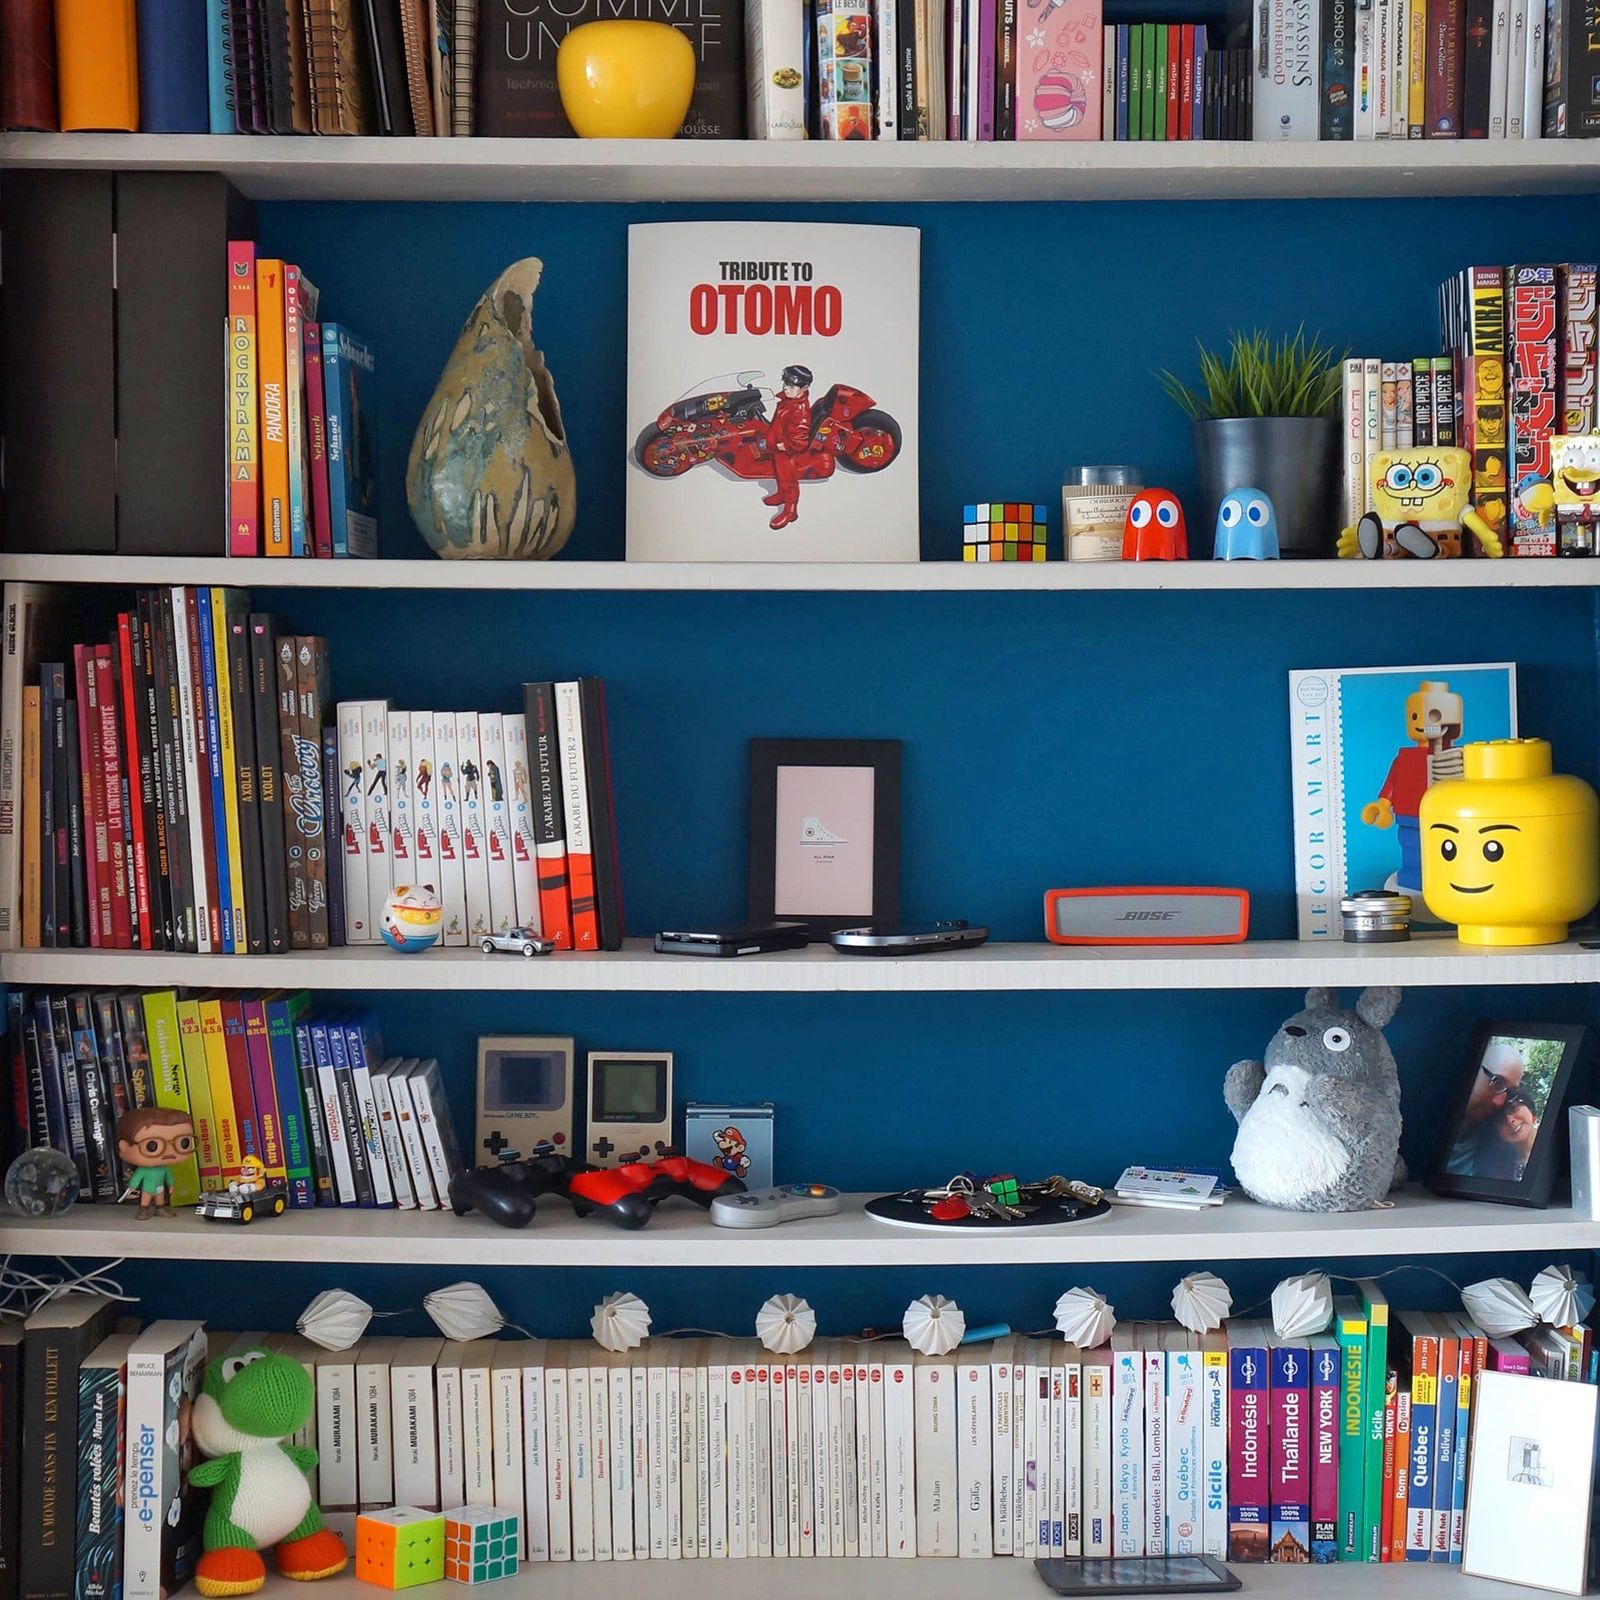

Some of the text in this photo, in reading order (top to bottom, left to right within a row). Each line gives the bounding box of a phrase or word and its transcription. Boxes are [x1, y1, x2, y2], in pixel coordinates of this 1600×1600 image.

[1362, 17, 1370, 62] TrackMania
[906, 73, 912, 82] sa
[1447, 41, 1455, 109] REVELATION
[905, 90, 913, 110] Sushi
[719, 261, 812, 281] TRIBUTE TO
[1518, 268, 1553, 284] 少年
[288, 287, 296, 333] OTOMO
[690, 284, 842, 336] OTOMO
[1475, 292, 1504, 354] AKIRA
[235, 318, 250, 481] ROCKYRAMA
[267, 383, 283, 442] PANDORA
[1352, 390, 1360, 439] FLCL
[1369, 391, 1377, 439] FLCL
[1416, 375, 1430, 423] ONE PIECE
[1437, 375, 1452, 439] ONE PIECE 69
[330, 414, 338, 461] Schnock
[87, 660, 96, 707] FLUIDE GLACIAL
[148, 688, 156, 714] VENDRE
[170, 686, 178, 717] BLACKSAD
[207, 686, 215, 716] BLACKSAD
[149, 726, 158, 748] FIERTÉ
[150, 716, 157, 724] DE
[100, 705, 121, 829] LA FONTAINE DE MÉDIOCRITÉ
[240, 765, 253, 802] AXOLOT
[261, 765, 274, 802] AXOLOT
[538, 735, 551, 791] DU FUTUR
[568, 745, 579, 781] FUTUR
[168, 783, 176, 824] SHOTGUN ET
[570, 784, 580, 800] DU
[0, 801, 13, 834] BLOTCH
[157, 814, 166, 847] BARCCO
[1305, 712, 1328, 937] LEGORAMART
[159, 849, 168, 875] DIDIER
[1, 907, 10, 931] BLOTCH
[1115, 911, 1181, 920] BOSE
[204, 1017, 218, 1026] vol.
[247, 1017, 261, 1027] vol.
[299, 1041, 308, 1063] PS4
[318, 1041, 326, 1064] PS4
[334, 1043, 344, 1064] PS4
[352, 1043, 360, 1065] PS4
[85, 1071, 98, 1098] Chris
[131, 1068, 146, 1102] Spike
[171, 1064, 181, 1096] Serge
[264, 1114, 277, 1164] strip-tease
[287, 1115, 301, 1164] strip-tease
[326, 1103, 340, 1141] DIVISION
[341, 1082, 354, 1117] Uncharted
[352, 1133, 361, 1156] Thief's
[364, 1098, 383, 1160] TRACKMANIA
[199, 1119, 212, 1163] strip-tease
[222, 1119, 234, 1163] strip-tease
[1345, 1345, 1361, 1436] INDONÉSIE
[43, 1347, 59, 1526] MONDE SANS FIN KEN FOLLETT
[333, 1405, 341, 1447] MURAKAMI
[370, 1403, 378, 1445] MURAKAMI
[409, 1405, 418, 1448] MURAKAMI
[670, 1433, 678, 1454] Zadig
[1240, 1394, 1258, 1478] Indonésie
[1282, 1392, 1299, 1484] Thaïlande
[1319, 1390, 1333, 1464] NEW YORK
[1372, 1410, 1384, 1440] Sicile
[1384, 1409, 1395, 1479] Cartoville TOKYO
[89, 1393, 104, 1534] Beautés volées Mara Lee
[554, 1458, 562, 1481] Barbery
[1208, 1389, 1222, 1510] Sicile routard
[1457, 1437, 1466, 1481] Amsterdam
[130, 1442, 139, 1509] prenez temps
[138, 1423, 158, 1522] e-penser
[1120, 1427, 1131, 1536] Japon Tokyo, Kyoto
[1151, 1417, 1162, 1538] Indonésie Bali, Lombok
[1176, 1448, 1189, 1501] Québec
[1396, 1468, 1406, 1499] Rome
[1413, 1425, 1429, 1548] petit futé Québec
[1435, 1428, 1451, 1550] petit futé Bolivie
[654, 1489, 662, 1510] André
[932, 1480, 941, 1512] Ma Jian
